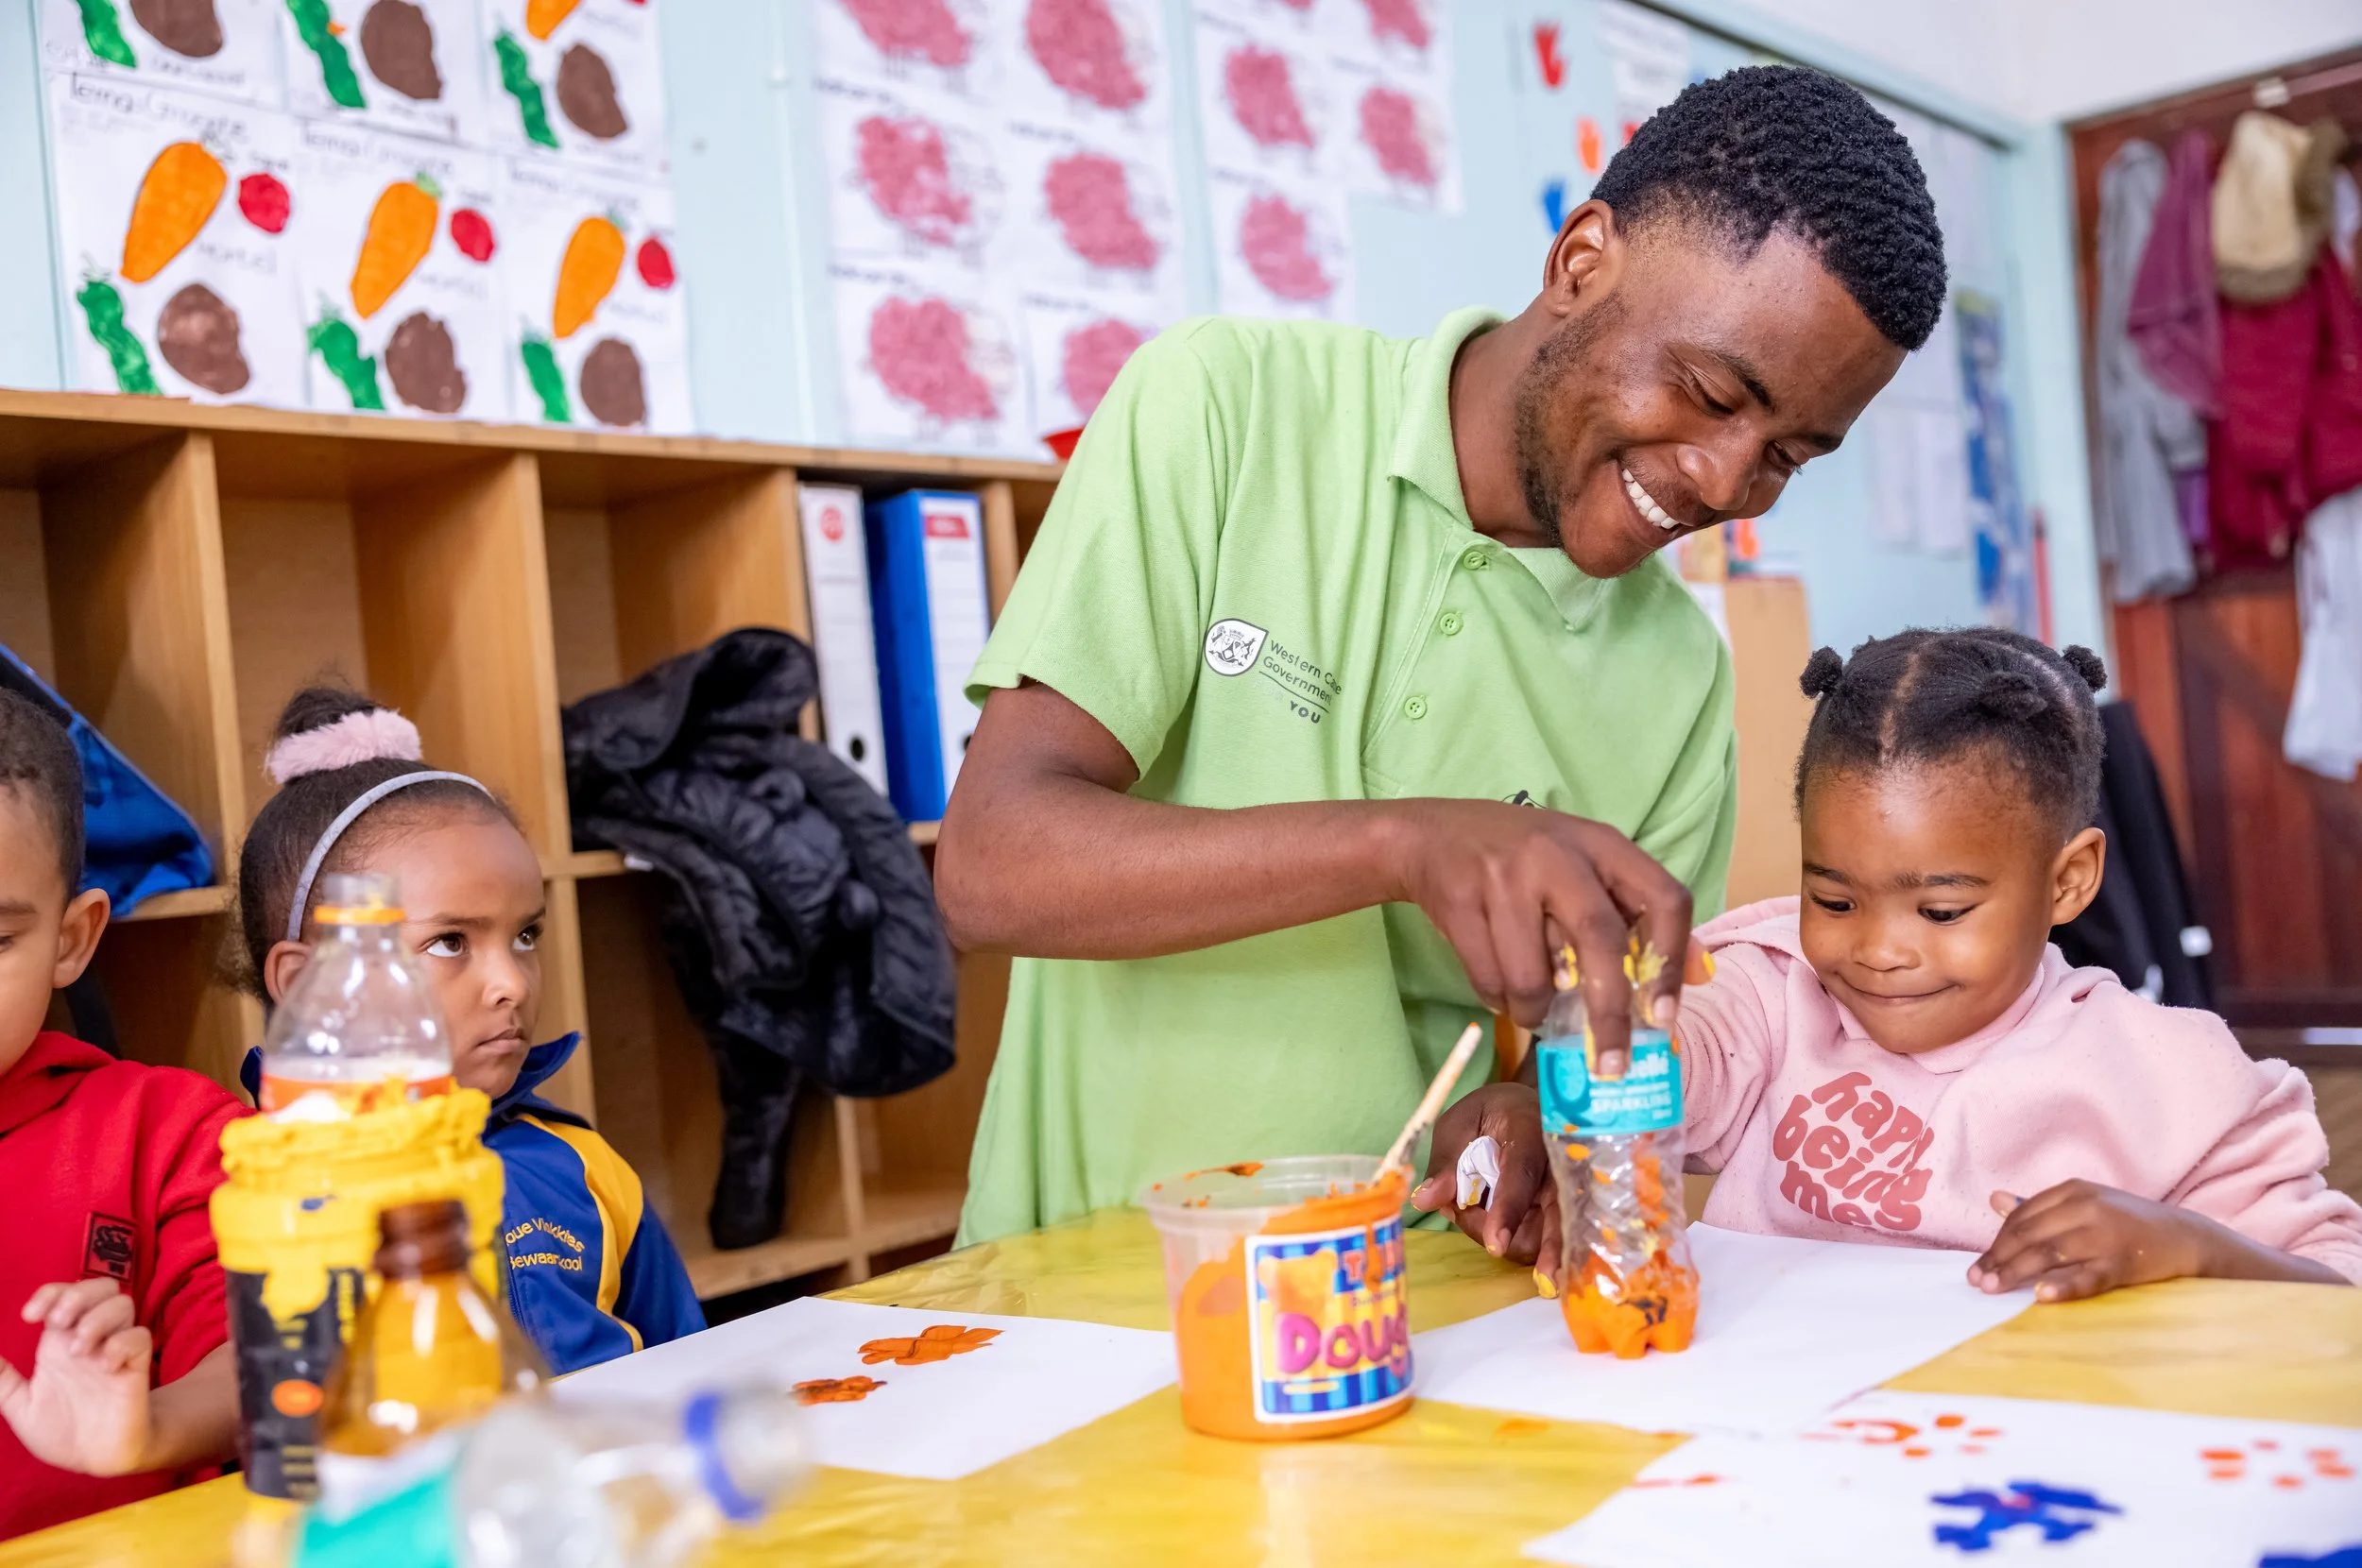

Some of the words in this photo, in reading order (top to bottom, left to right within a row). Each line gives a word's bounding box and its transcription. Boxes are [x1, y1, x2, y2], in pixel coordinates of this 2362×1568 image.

[1271, 639, 1322, 679] Western
[1324, 672, 1343, 695] Cae
[1290, 700, 1321, 724] YOU
[1811, 1071, 1935, 1174] happy
[1772, 1094, 1934, 1232] being
[1779, 1160, 1873, 1226] me
[505, 1222, 534, 1245] oue
[509, 1252, 583, 1271] ewaarkool
